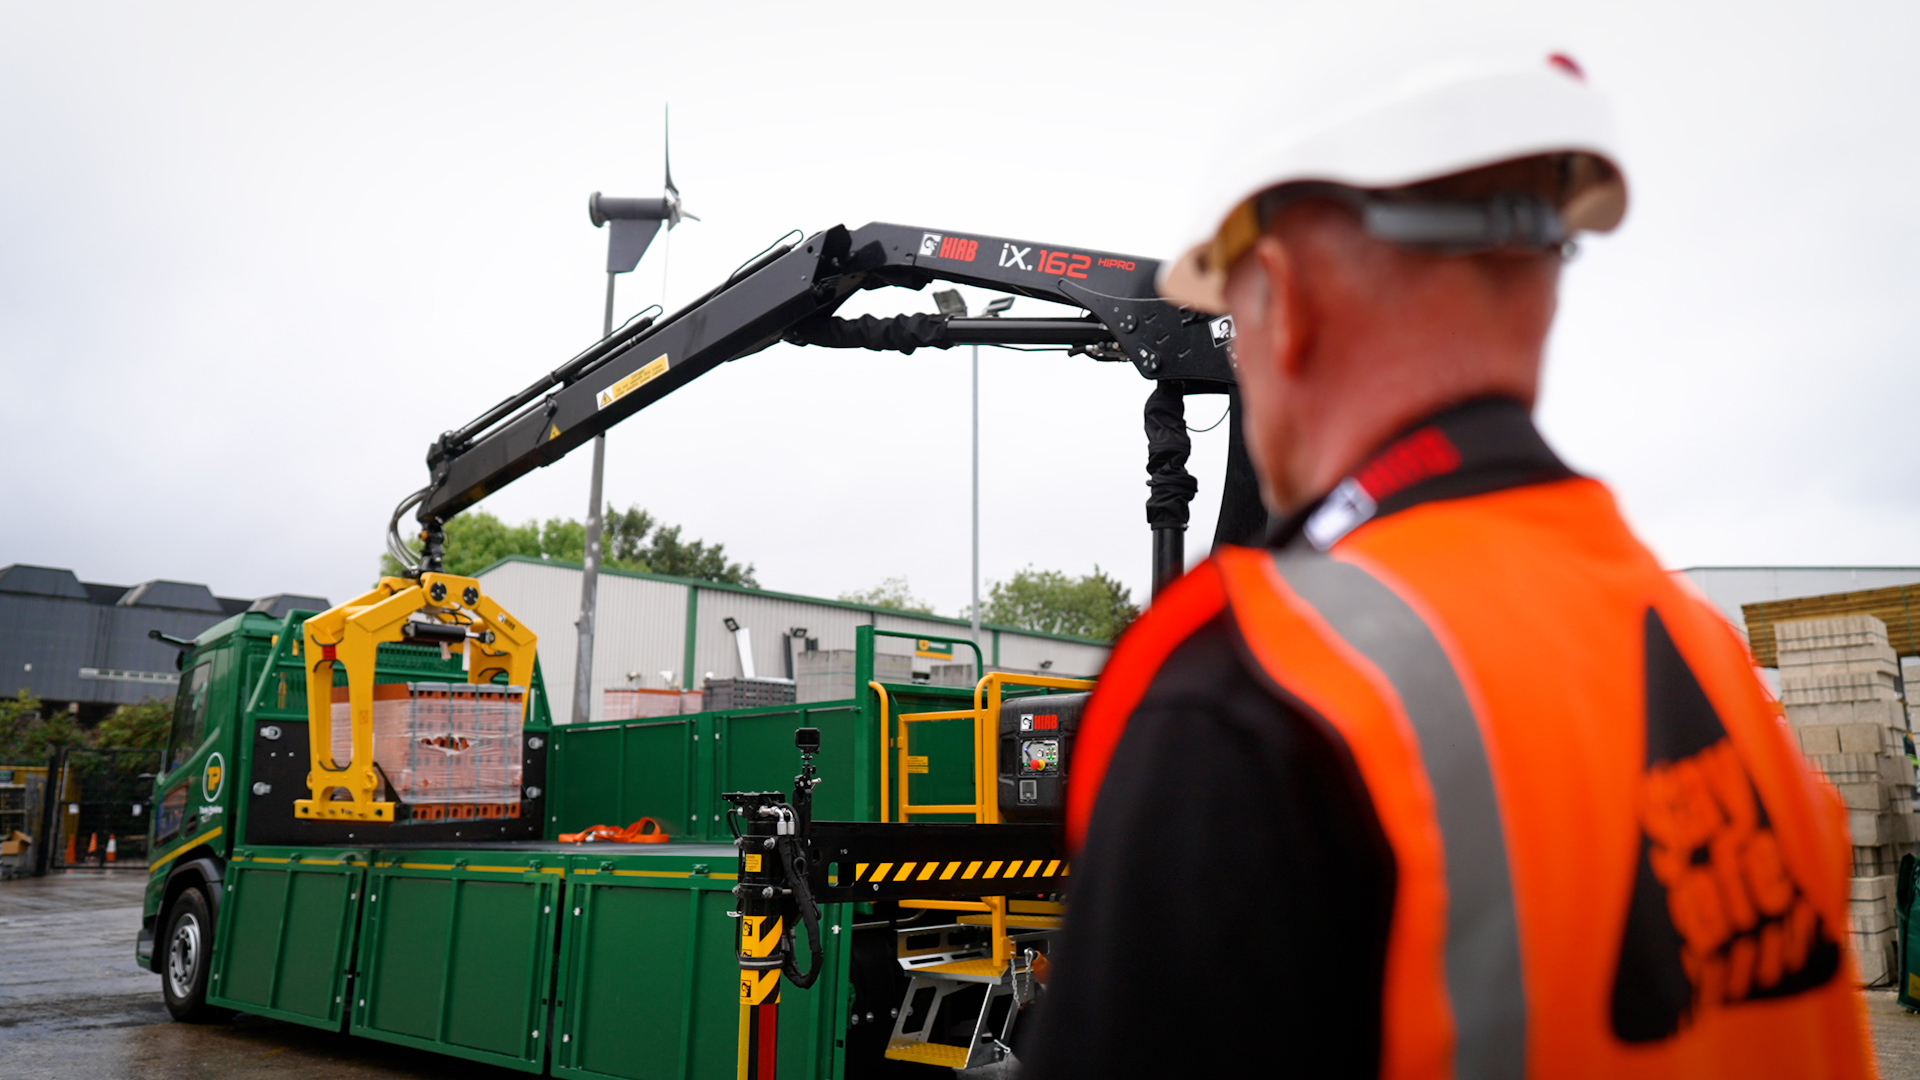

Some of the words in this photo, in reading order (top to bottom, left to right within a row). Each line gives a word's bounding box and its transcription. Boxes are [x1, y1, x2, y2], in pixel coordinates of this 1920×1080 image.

[938, 236, 979, 262] HIAB
[1097, 257, 1136, 272] HIPRO
[1033, 714, 1058, 730] HIAB
